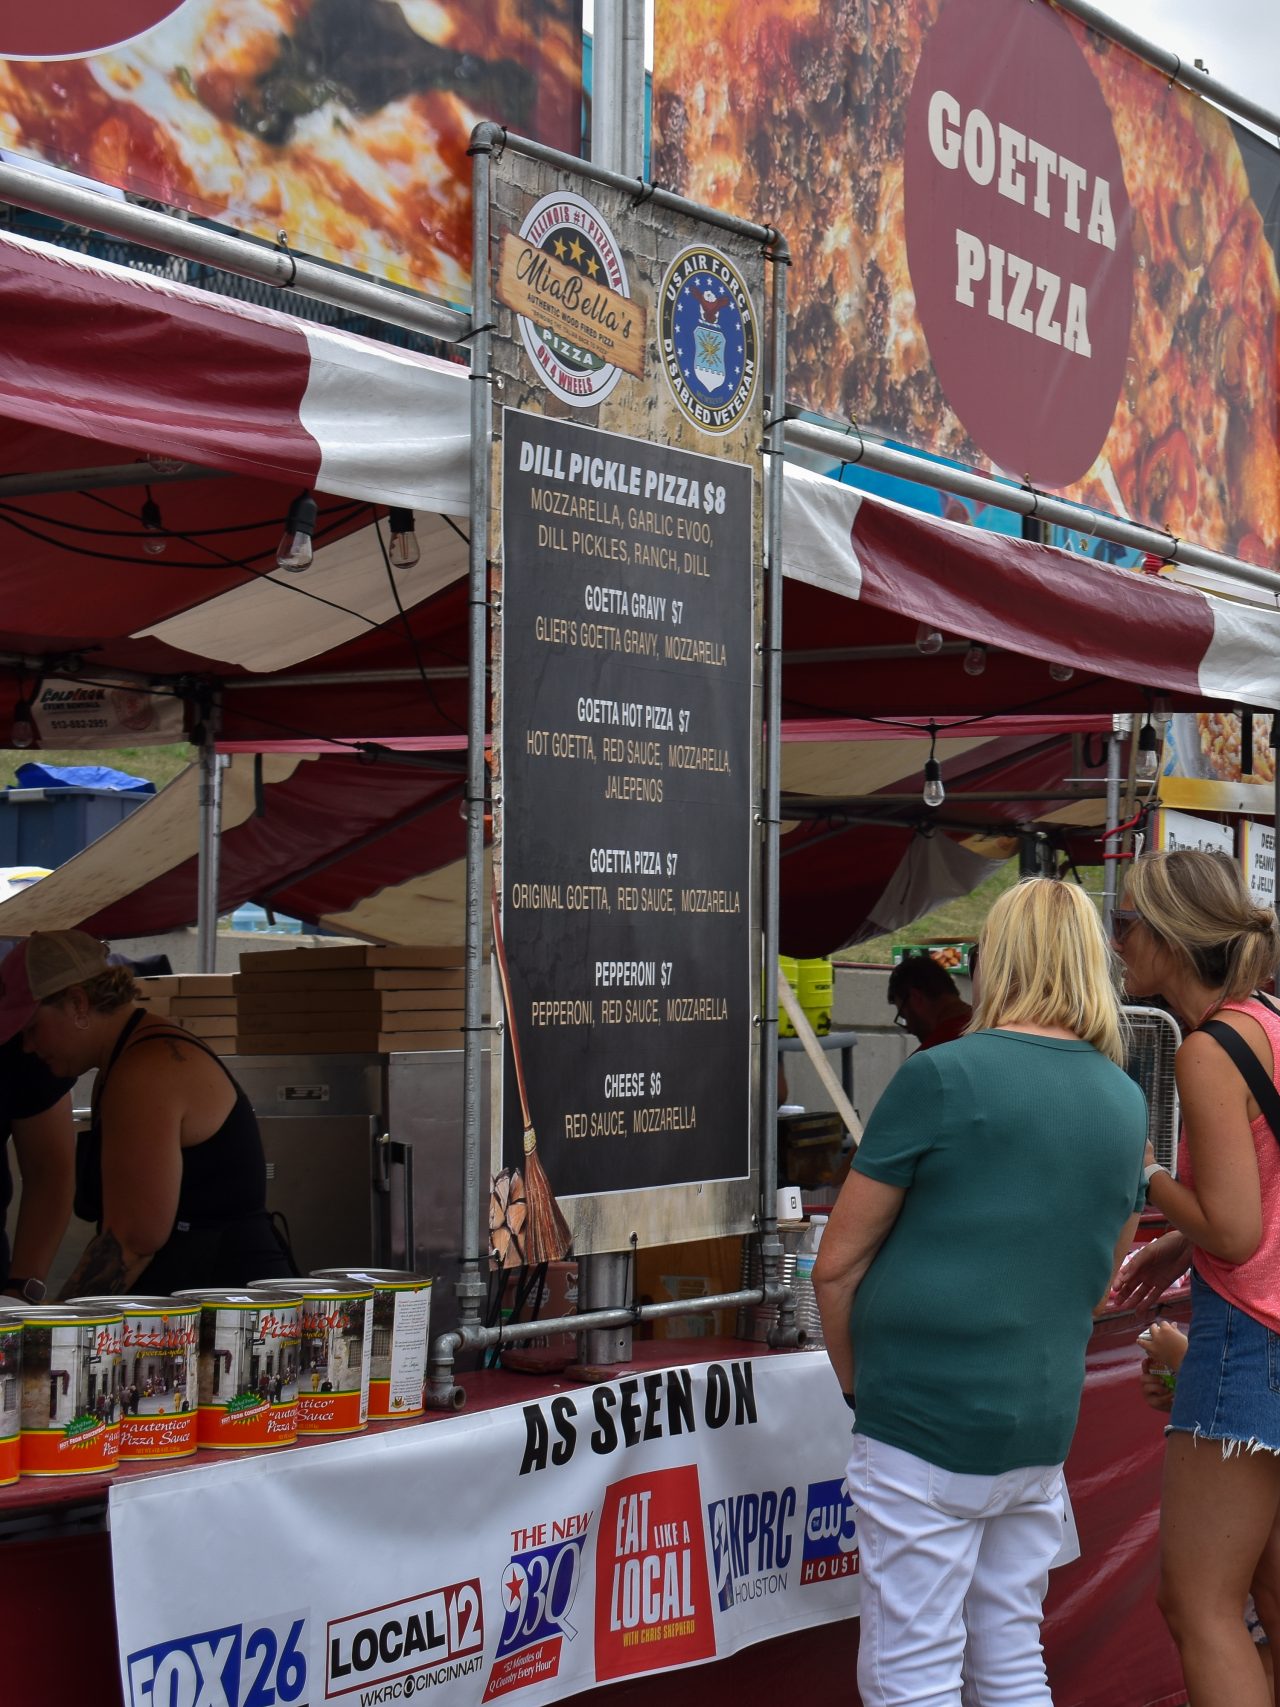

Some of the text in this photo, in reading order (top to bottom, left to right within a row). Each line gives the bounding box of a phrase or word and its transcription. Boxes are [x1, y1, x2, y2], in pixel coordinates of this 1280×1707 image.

[928, 90, 1116, 251] GOETTA
[531, 206, 622, 288] ILLINOIS #1 PIZZERIA
[516, 248, 632, 338] MiaBella's
[666, 255, 750, 324] US AIR FORCE
[956, 228, 1091, 358] PIZZA
[528, 293, 614, 347] AUTHENTIC WOOD FIRED PIZZA
[543, 329, 592, 365] PIZZA
[538, 345, 592, 393] ON 4 WHEELS
[664, 338, 755, 425] DISABLED VETERAN
[519, 441, 725, 515] DILL PICKLE PIZZA $8
[532, 488, 714, 547] MOZZARELLA, GARLIC EVOO,
[538, 524, 710, 577] DILL PICKLES, RANCH, DILL
[585, 585, 683, 624] GOETTA GRAVY $7
[536, 616, 726, 666] GLIER'S GOETTA GRAVY, MOZZARELLA
[578, 697, 689, 733] GOETTA HOT PIZZA $7
[527, 731, 731, 774] HOT GOETTA, RED SAUCE, MOZZARELLA,
[606, 775, 662, 803] JALEPENOS
[1261, 833, 1275, 850] DEE
[590, 849, 678, 876] GOETTA PIZZA $7
[1255, 853, 1275, 872] PEANU
[512, 884, 740, 915] ORIGINAL GOETTA, RED SAUCE, MOZZARELLA
[1257, 876, 1273, 893] JELLY
[595, 961, 672, 987] PEPPERONI $7
[532, 998, 727, 1027] PEPPERONI, RED SAUCE, MOZZARELLA
[605, 1071, 661, 1098] CHEESE $6
[565, 1106, 696, 1138] RED SAUCE, MOZZARELLA
[267, 1420, 290, 1433] Pizza
[297, 1409, 334, 1421] Sauce
[519, 1362, 758, 1476] AS SEEN ON
[120, 1433, 154, 1445] Pizza
[159, 1431, 190, 1445] Sauce
[511, 1510, 594, 1552] THE NEW
[615, 1492, 690, 1558] EAT LIKE A
[728, 1487, 796, 1579] KPRC
[806, 1555, 858, 1580] HOUST
[610, 1549, 695, 1632] LOCAL
[735, 1573, 787, 1605] HOUSTON
[331, 1585, 481, 1679] LOCAL 12
[623, 1621, 695, 1647] WITH CHRIS SHEPHERD
[128, 1618, 306, 1707] FOX 26
[513, 1653, 534, 1669] Minutes
[536, 1647, 543, 1657] of
[360, 1656, 483, 1707] WKRC CINCINNATI
[490, 1681, 495, 1692] Q
[496, 1673, 517, 1688] Country
[518, 1665, 534, 1679] Every
